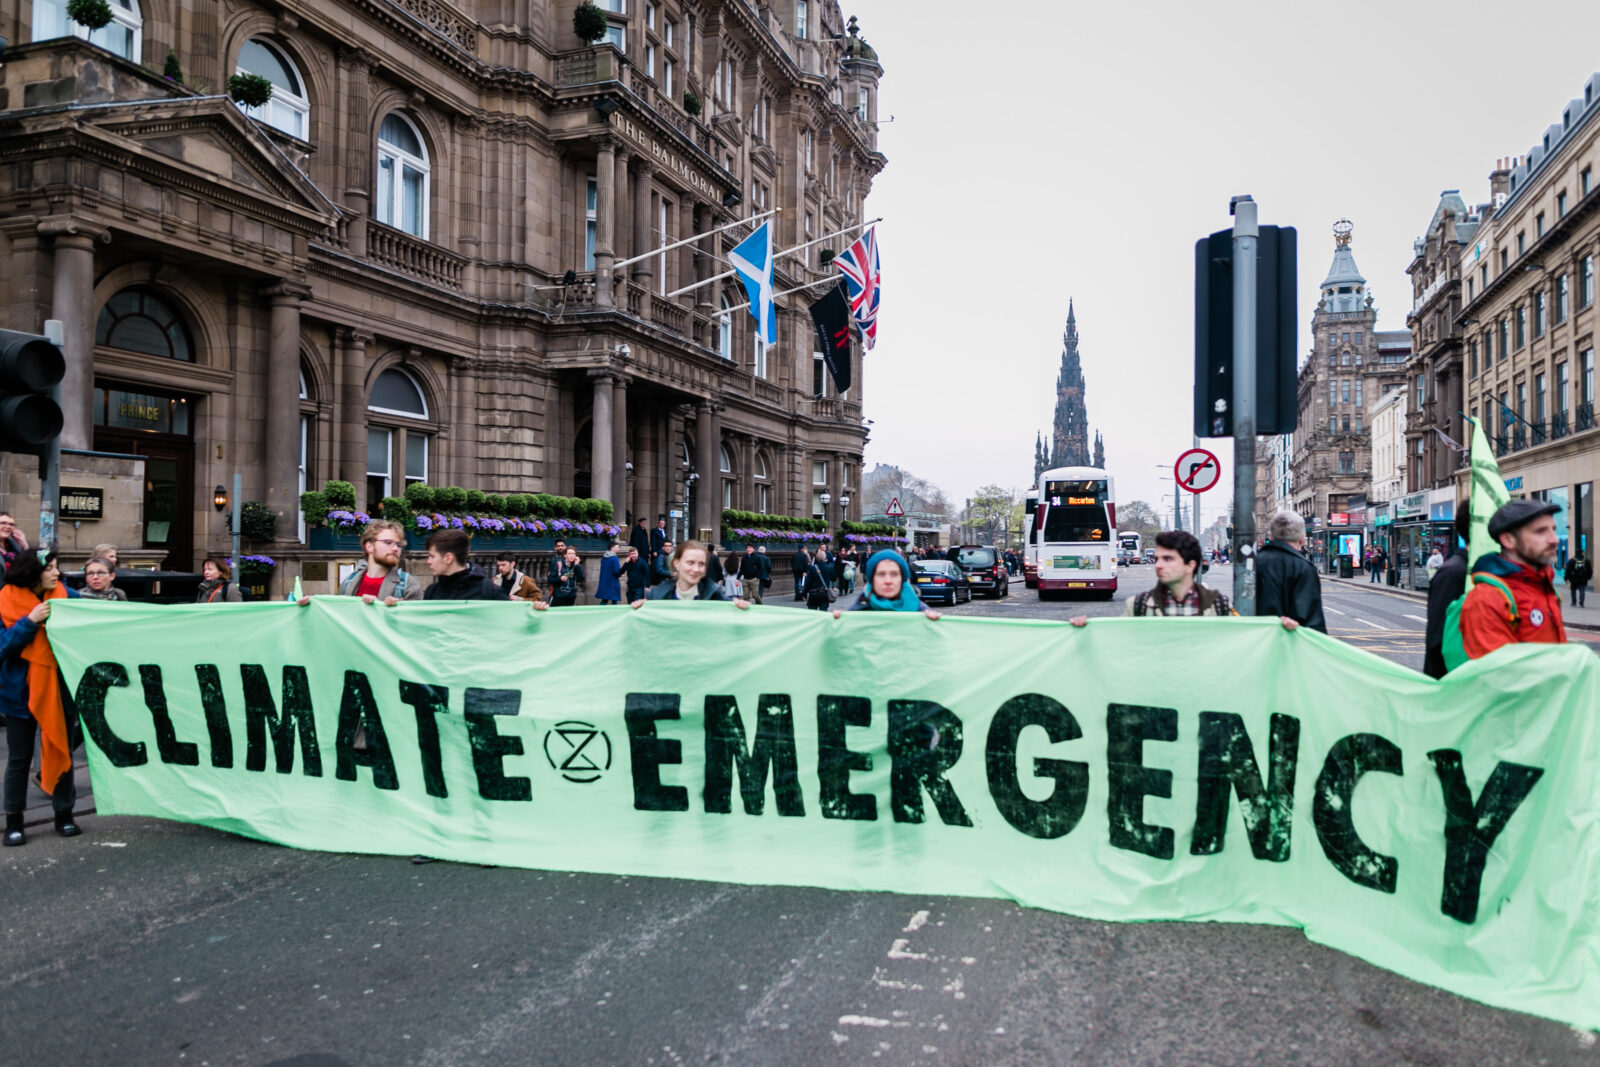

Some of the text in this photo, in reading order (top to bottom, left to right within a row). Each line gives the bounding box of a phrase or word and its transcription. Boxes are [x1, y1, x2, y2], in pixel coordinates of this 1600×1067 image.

[614, 111, 723, 203] THE BALMORAL
[119, 403, 159, 420] PRINCE
[61, 495, 100, 511] PRINCE
[1052, 496, 1061, 506] 34
[75, 661, 1545, 925] CLIMATE EMERGENCY
